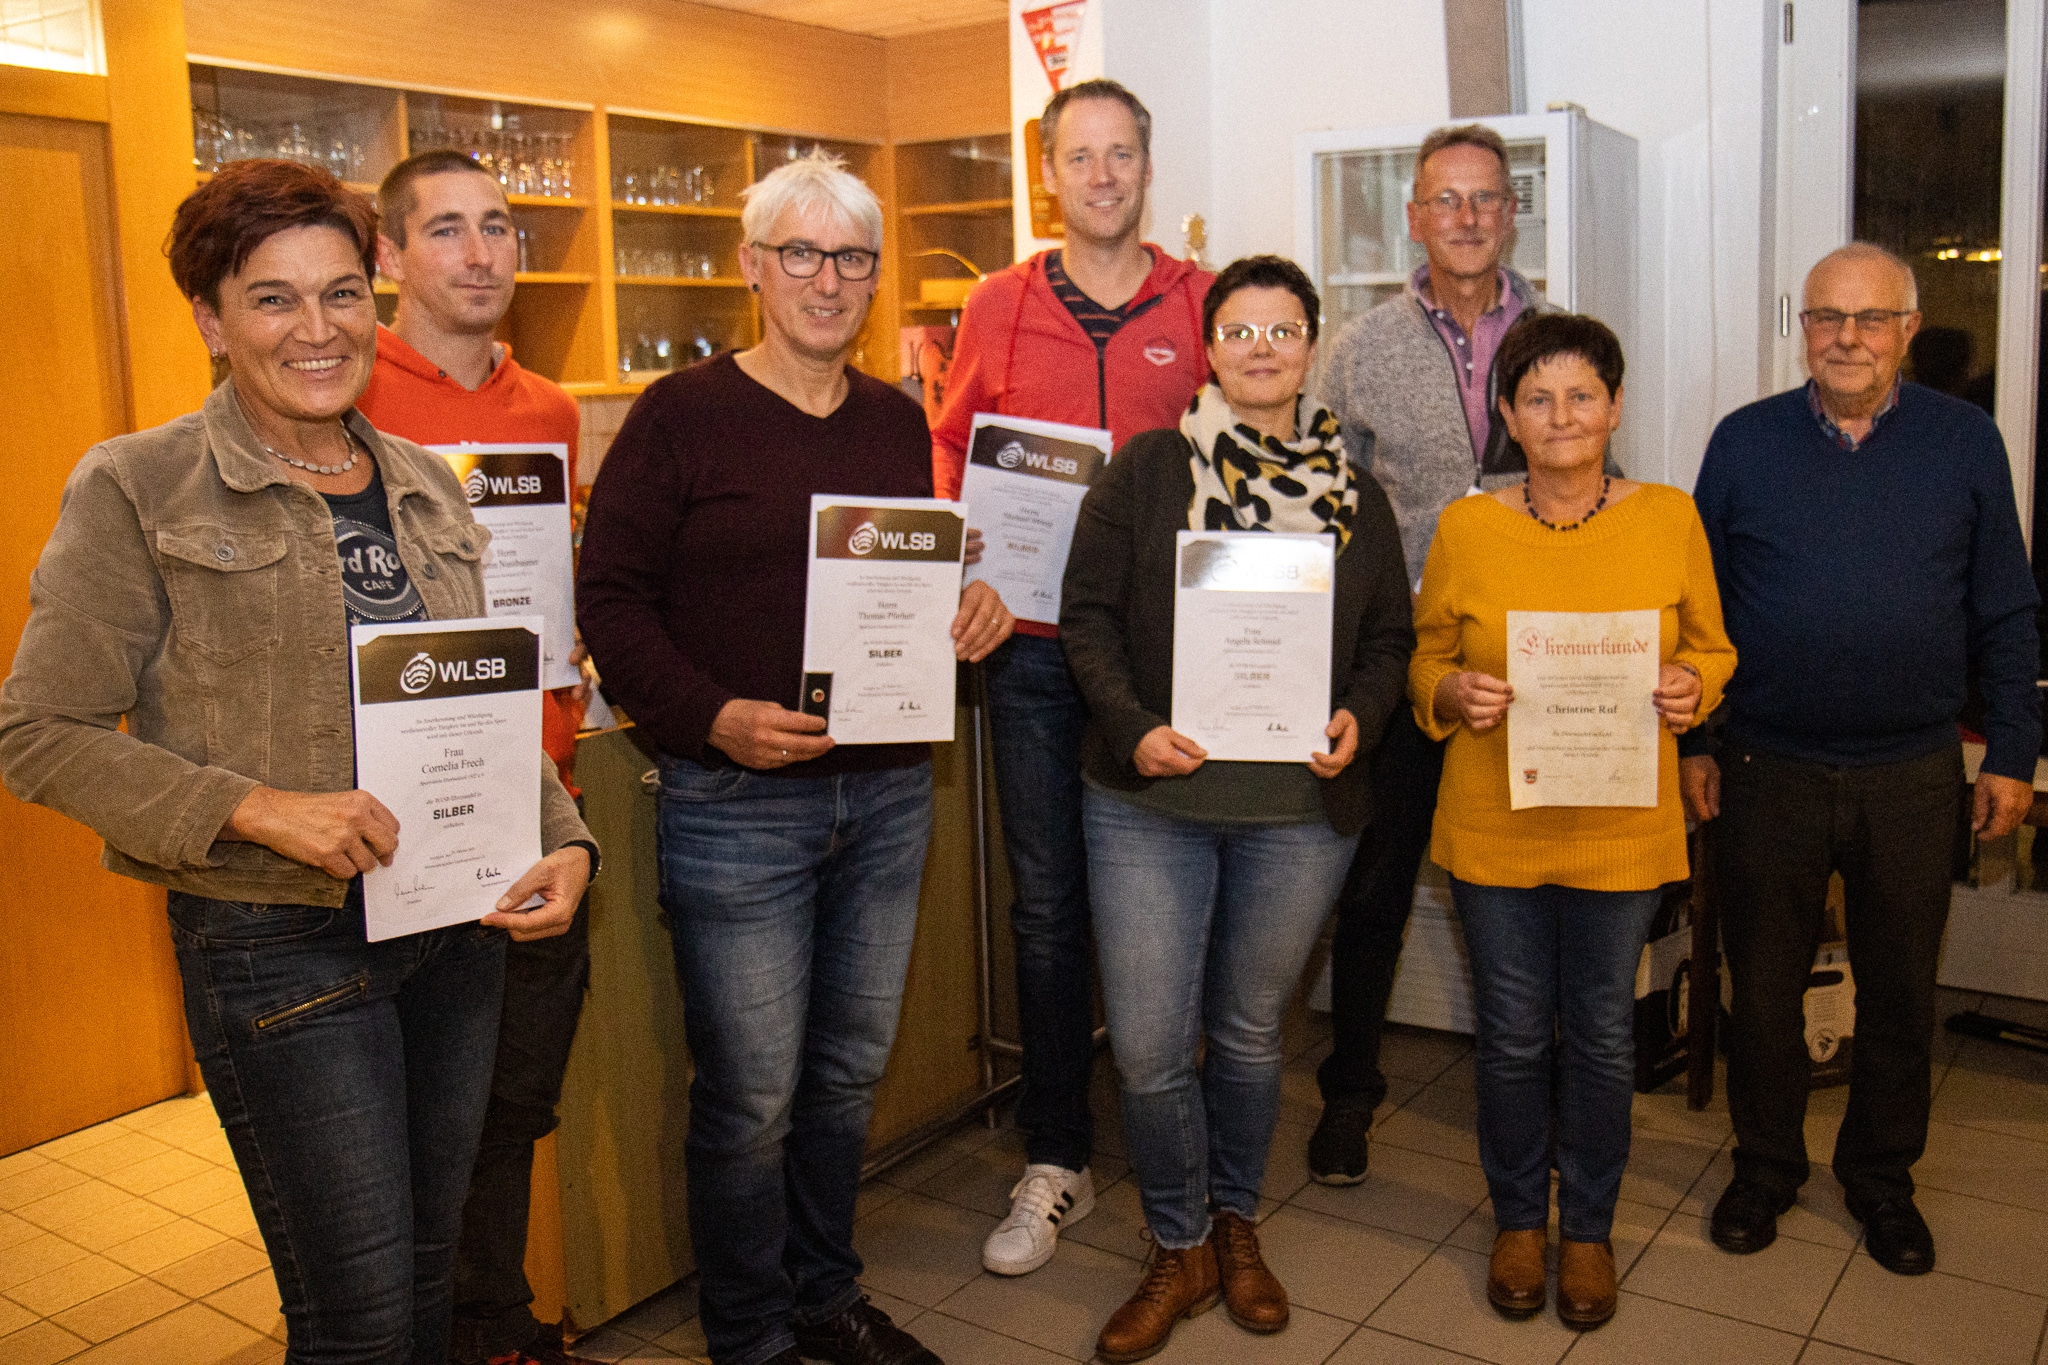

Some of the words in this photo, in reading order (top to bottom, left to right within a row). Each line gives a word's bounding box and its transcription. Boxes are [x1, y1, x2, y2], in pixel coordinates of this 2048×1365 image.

[1025, 452, 1077, 475] WLSB
[489, 476, 542, 495] WLSB
[880, 532, 936, 551] WLSB
[338, 547, 364, 574] rd
[365, 545, 400, 577] Ro
[1242, 564, 1298, 580] SB
[362, 580, 395, 591] CAFE
[492, 596, 531, 608] BRONZE
[1516, 627, 1650, 661] Ehrenurkunde
[868, 649, 903, 659] SILBER
[438, 657, 506, 683] WLSB
[1234, 671, 1271, 681] SILBER
[1546, 703, 1596, 715] Christine
[1598, 703, 1618, 715] Ruf
[444, 748, 464, 758] Frau
[421, 760, 459, 774] Cornelia
[461, 757, 485, 769] Frech
[433, 804, 475, 820] SILBER
